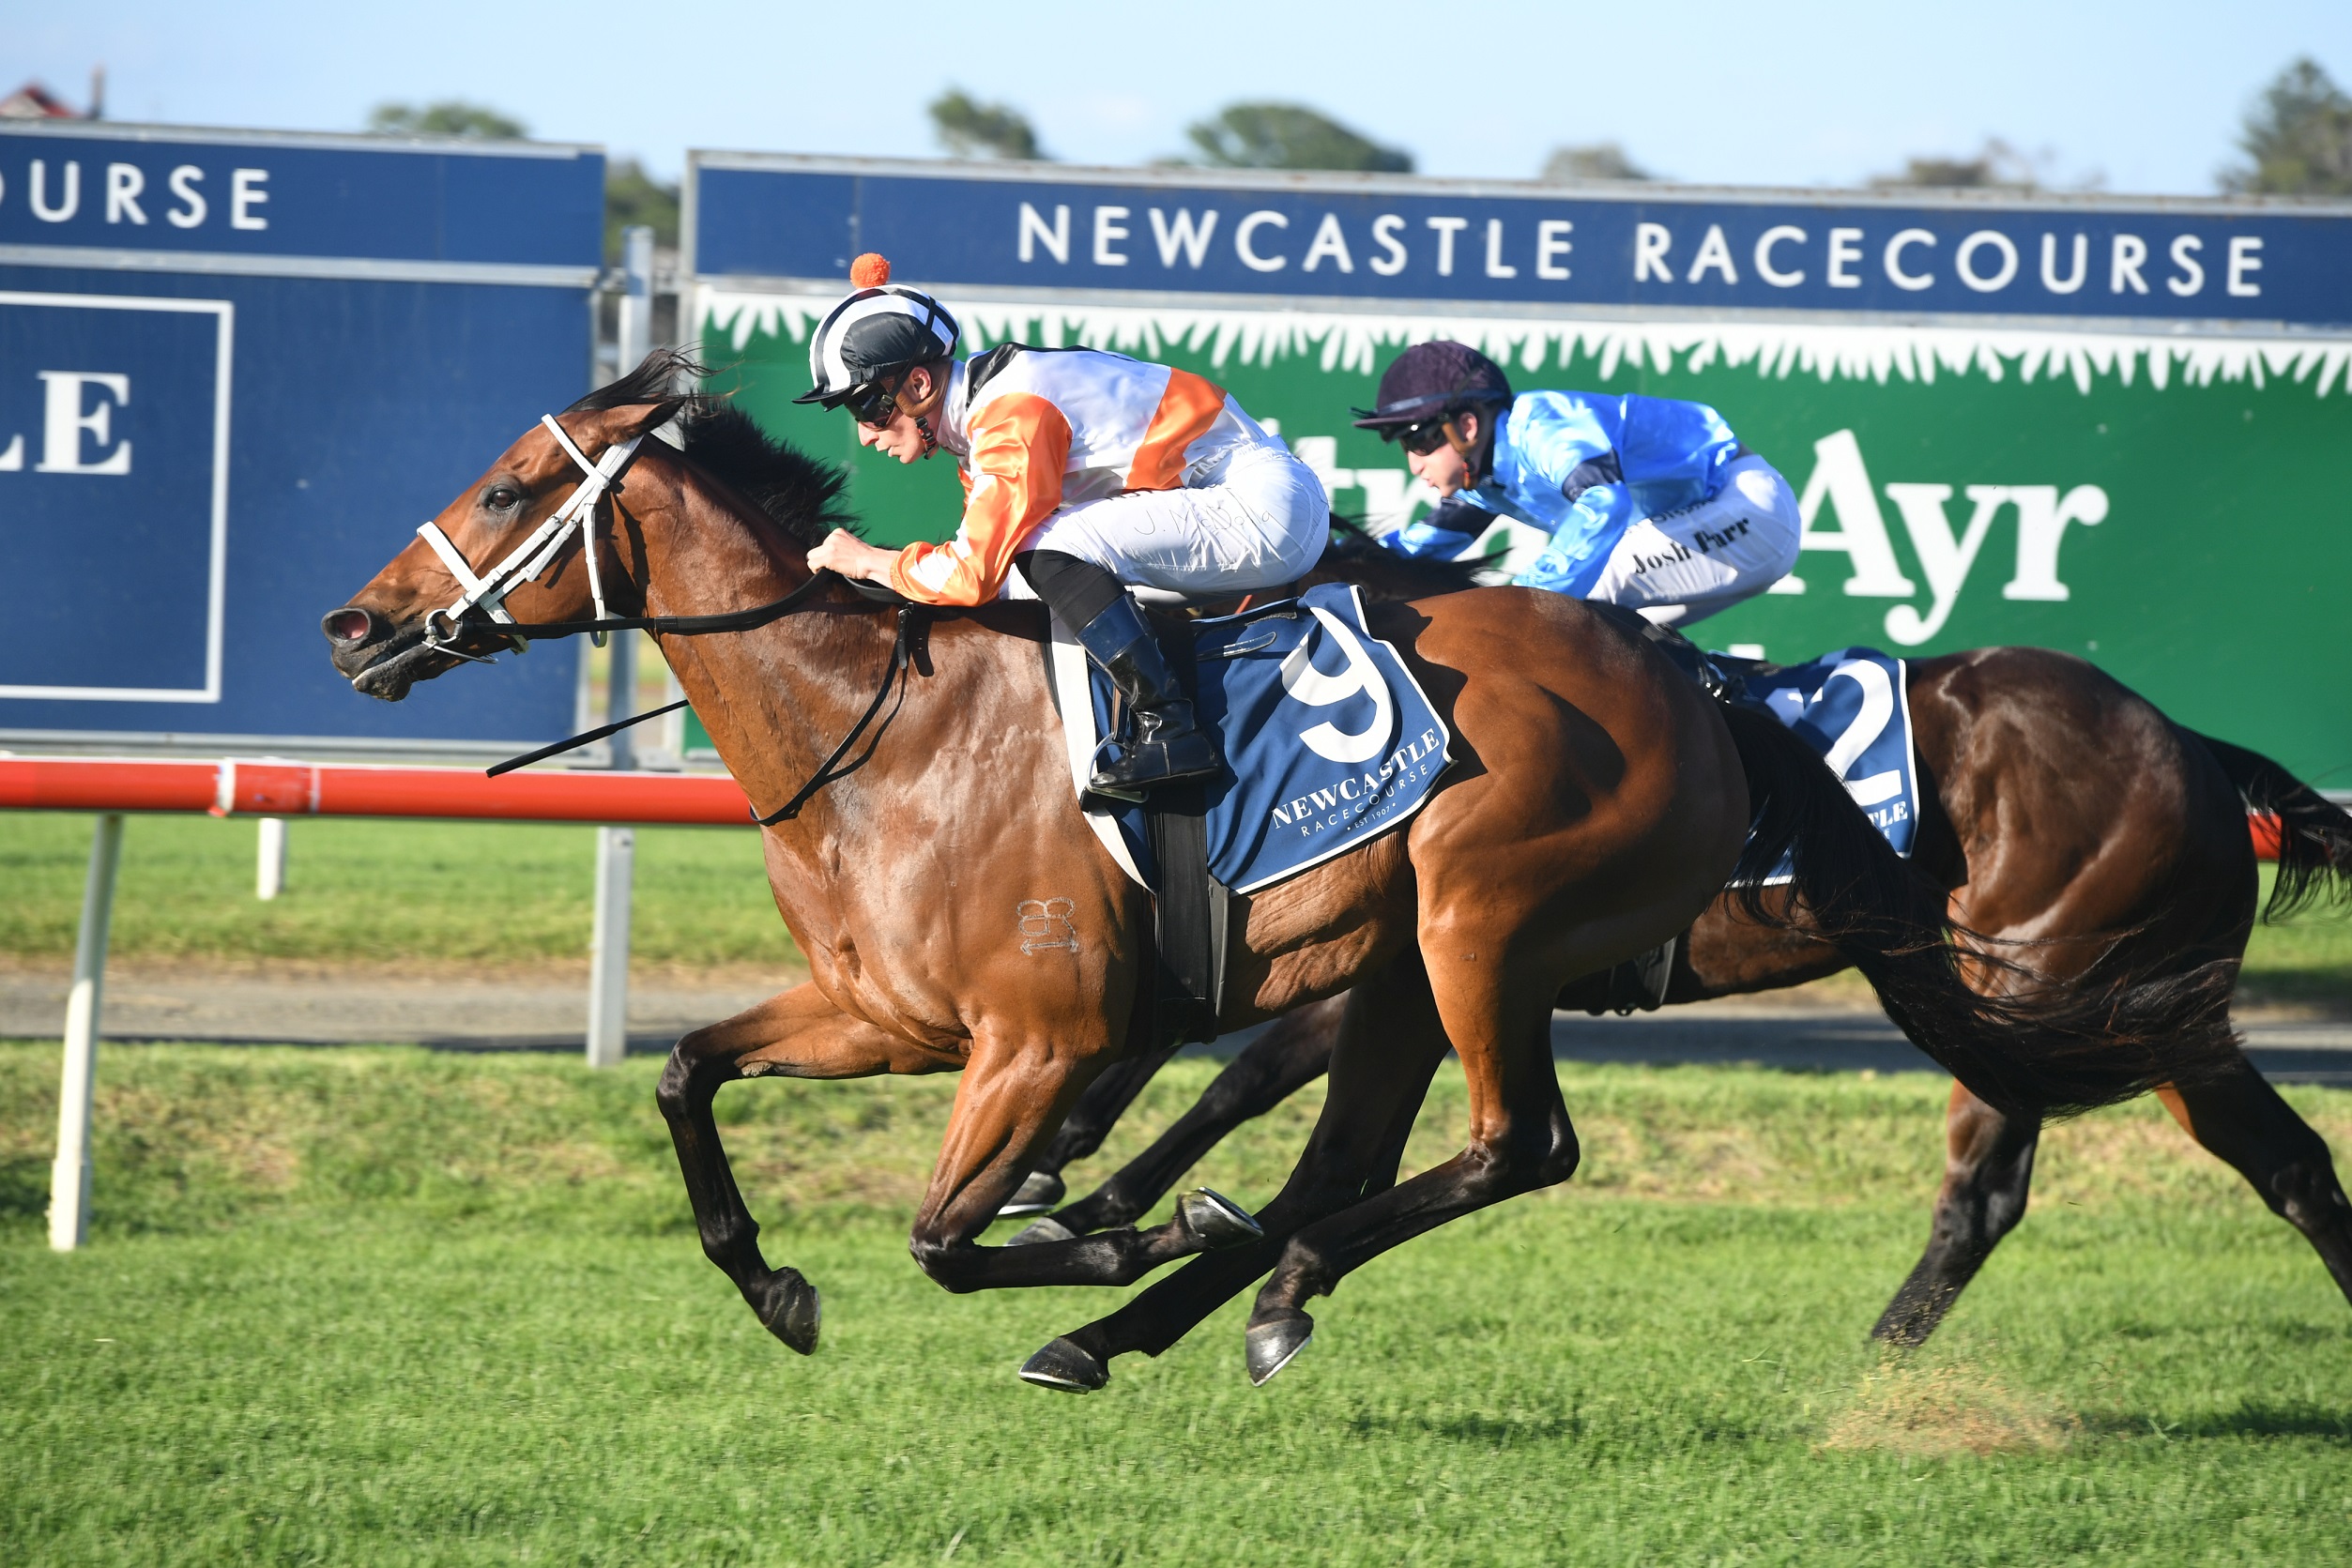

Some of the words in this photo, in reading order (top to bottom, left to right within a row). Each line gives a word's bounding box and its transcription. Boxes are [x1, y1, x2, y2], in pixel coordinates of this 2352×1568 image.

[0, 159, 269, 231] URSE
[1017, 202, 1573, 281] NEWCASTLE
[1633, 221, 2264, 297] RACECOURSE
[1631, 540, 1691, 574] Josh
[1278, 606, 1395, 763] 9
[1271, 727, 1441, 830] NEWCASTLE
[1300, 763, 1428, 837] RACECOURSE
[1354, 815, 1369, 830] EST
[1371, 805, 1391, 821] 1907
